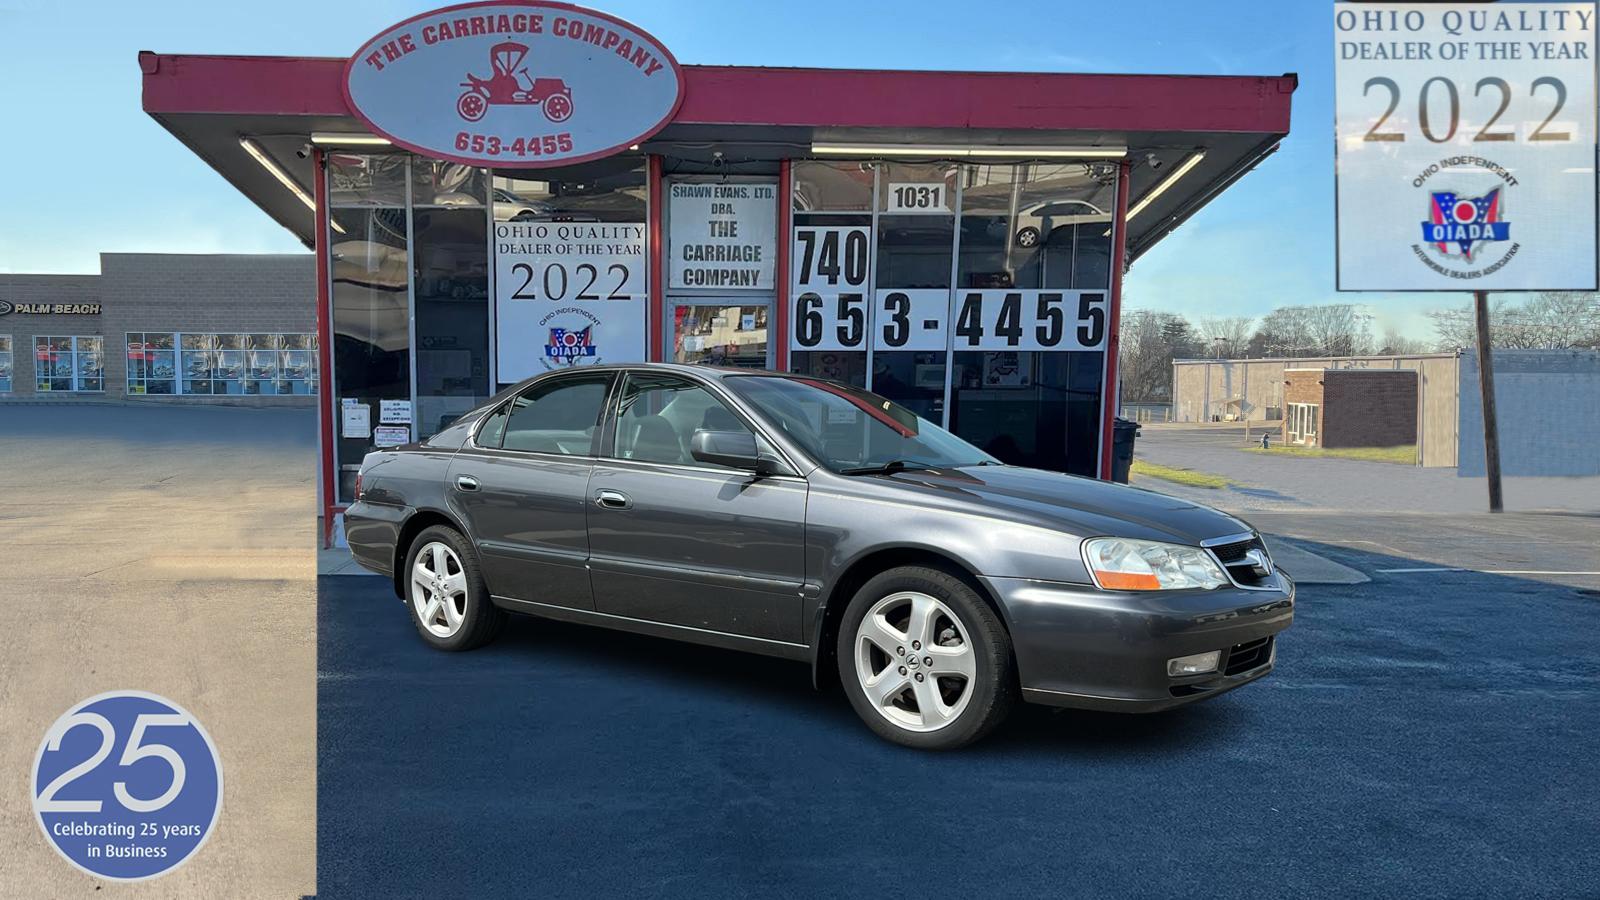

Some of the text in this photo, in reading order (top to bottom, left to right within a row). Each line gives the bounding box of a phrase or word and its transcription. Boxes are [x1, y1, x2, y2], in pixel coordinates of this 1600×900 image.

[1336, 10, 1593, 35] OHIO QUALITY
[366, 14, 664, 77] THE CARRIAGE COMPANY
[1340, 41, 1589, 60] DEALER OF THE YEAR
[1363, 76, 1570, 143] 2022
[455, 132, 572, 156] 653-4455
[1412, 155, 1519, 188] OHIO INDEPENDENT
[673, 186, 711, 198] SHAWN
[754, 187, 774, 199] LTD.
[894, 186, 941, 209] 1031
[711, 203, 736, 215] DBA.
[497, 226, 644, 240] OHIO QUALITY
[708, 221, 738, 237] THE
[1432, 224, 1495, 240] OIADA
[500, 243, 642, 255] DEALER OF THE YEAR
[683, 244, 762, 262] CARRIAGE
[797, 230, 867, 287] 740
[1411, 242, 1520, 279] AUTOMOBILE DEALERS ASSOCIATION
[511, 263, 631, 301] 2022
[683, 268, 760, 286] COMPANY
[14, 304, 100, 314] PALM BEACH
[539, 307, 601, 326] OHIO INDEPENDENT
[551, 347, 587, 356] OIADA
